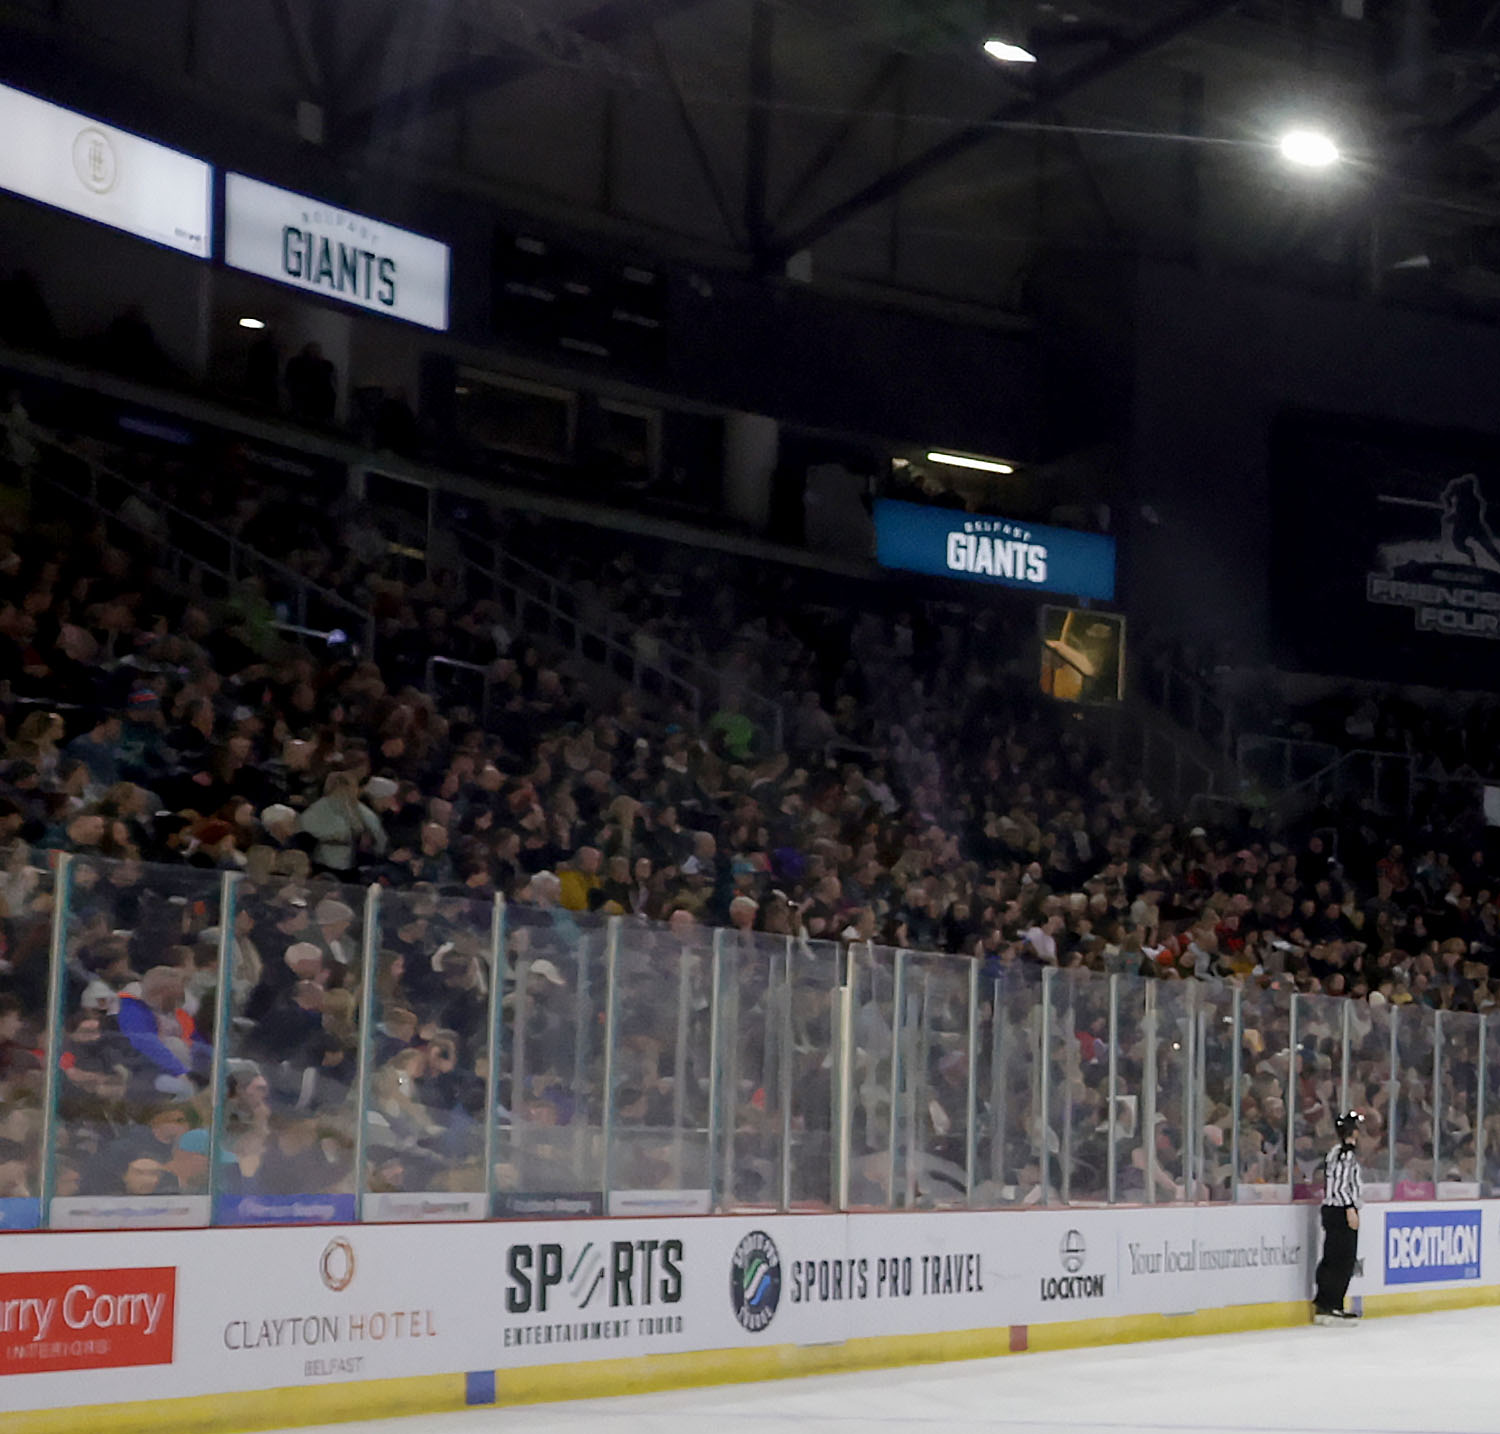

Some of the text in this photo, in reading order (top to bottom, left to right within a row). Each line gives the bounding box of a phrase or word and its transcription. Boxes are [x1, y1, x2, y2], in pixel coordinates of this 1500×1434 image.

[282, 225, 397, 307] GIANTS
[946, 531, 1048, 583] GIANTS
[789, 1253, 984, 1303] SPORTS PRO TRAVEL
[1127, 1241, 1163, 1276] Your
[1163, 1239, 1196, 1273] local
[1199, 1240, 1259, 1272] insurance
[62, 1283, 167, 1336] Corry
[1040, 1273, 1105, 1301] LOCKTON
[223, 1309, 438, 1351] CLAYTON HOTEL
[303, 1356, 365, 1377] BELFAST
